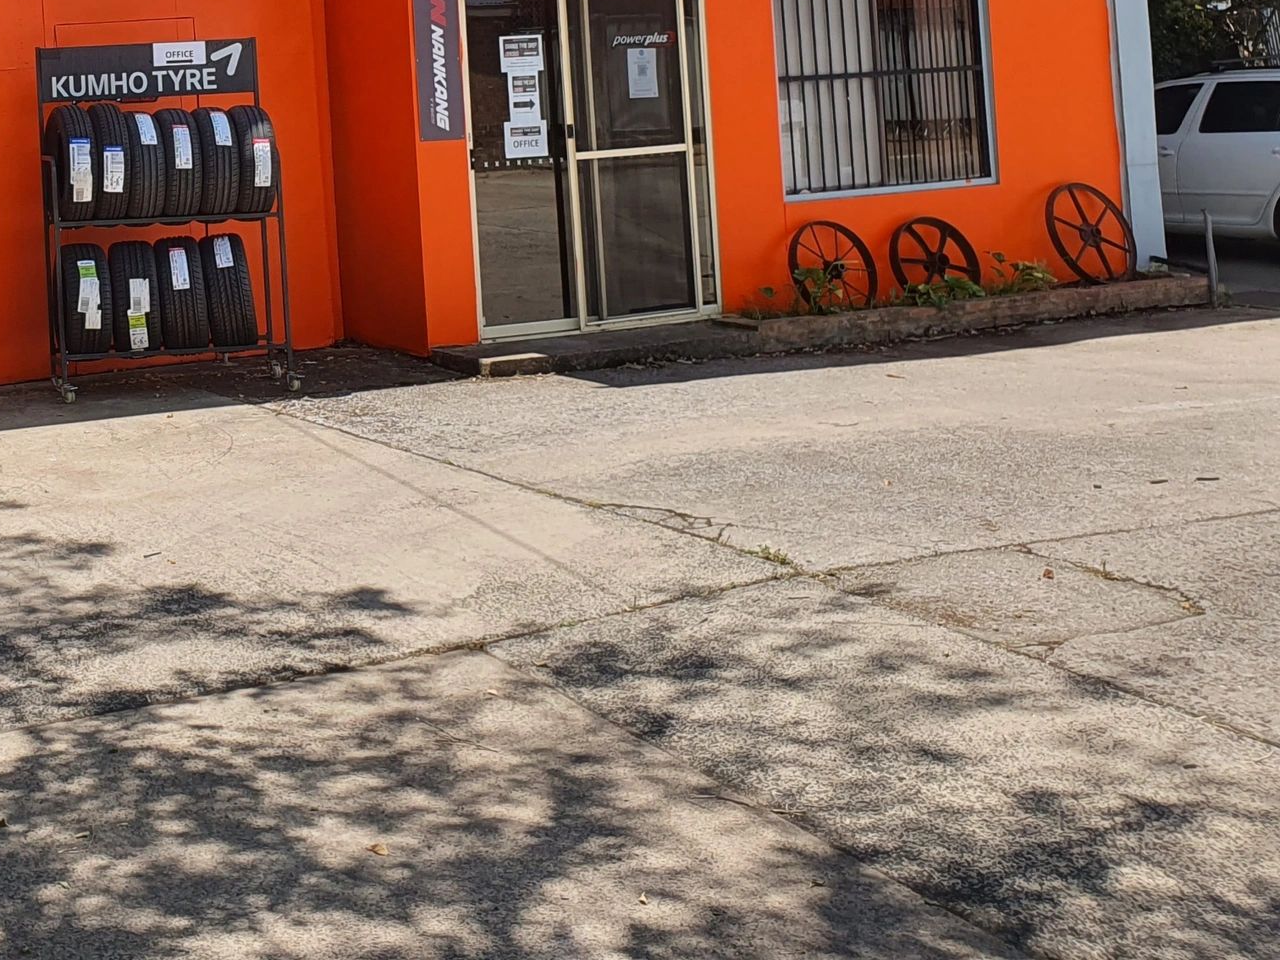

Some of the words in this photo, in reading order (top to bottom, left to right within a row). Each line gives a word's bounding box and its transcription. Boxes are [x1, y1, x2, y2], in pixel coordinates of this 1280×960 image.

[612, 32, 668, 47] powerplus
[165, 50, 195, 59] OFFICE
[51, 71, 148, 99] KUMHO
[152, 67, 218, 92] TYRE
[431, 24, 450, 131] NANKANG
[513, 139, 539, 148] OFFICE
